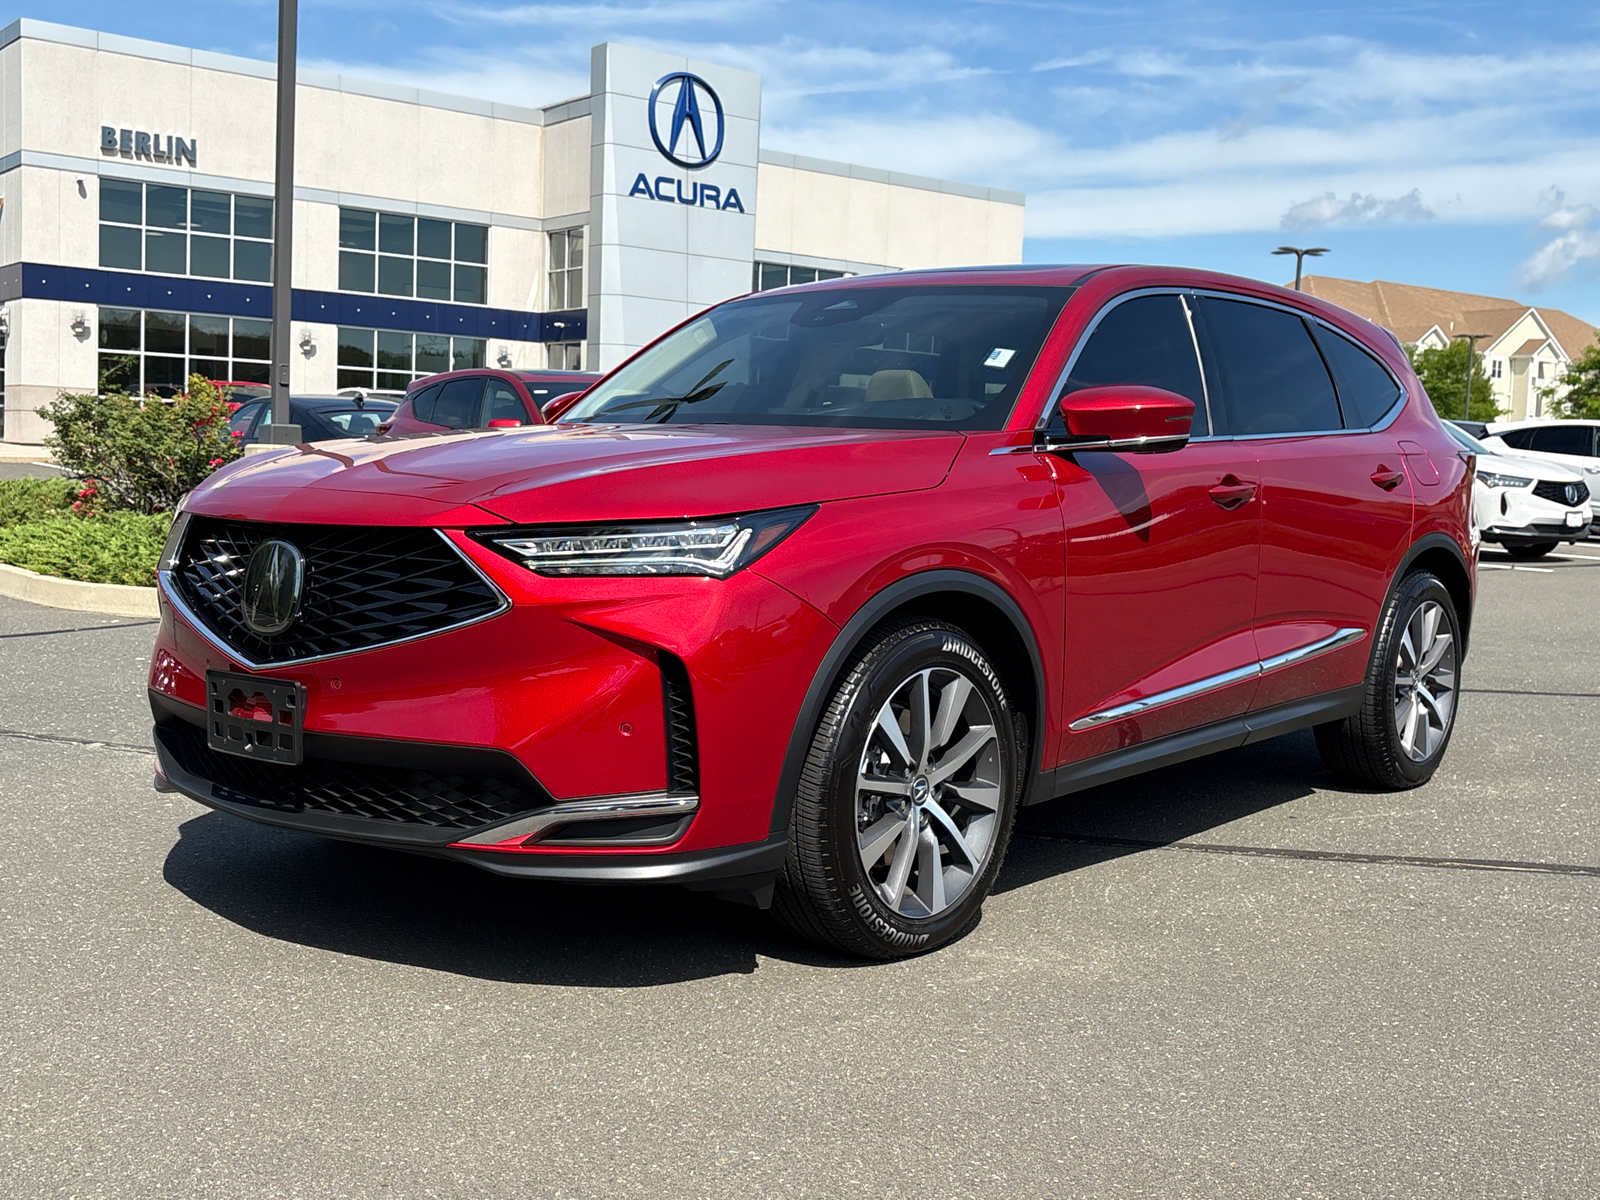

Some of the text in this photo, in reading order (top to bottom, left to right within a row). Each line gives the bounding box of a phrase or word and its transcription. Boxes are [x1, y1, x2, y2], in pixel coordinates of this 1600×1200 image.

[101, 125, 197, 165] BERLIN
[628, 172, 745, 213] ACURA
[942, 635, 1008, 711] BRIDGESTONE
[847, 883, 931, 948] BRIDGESTONE
